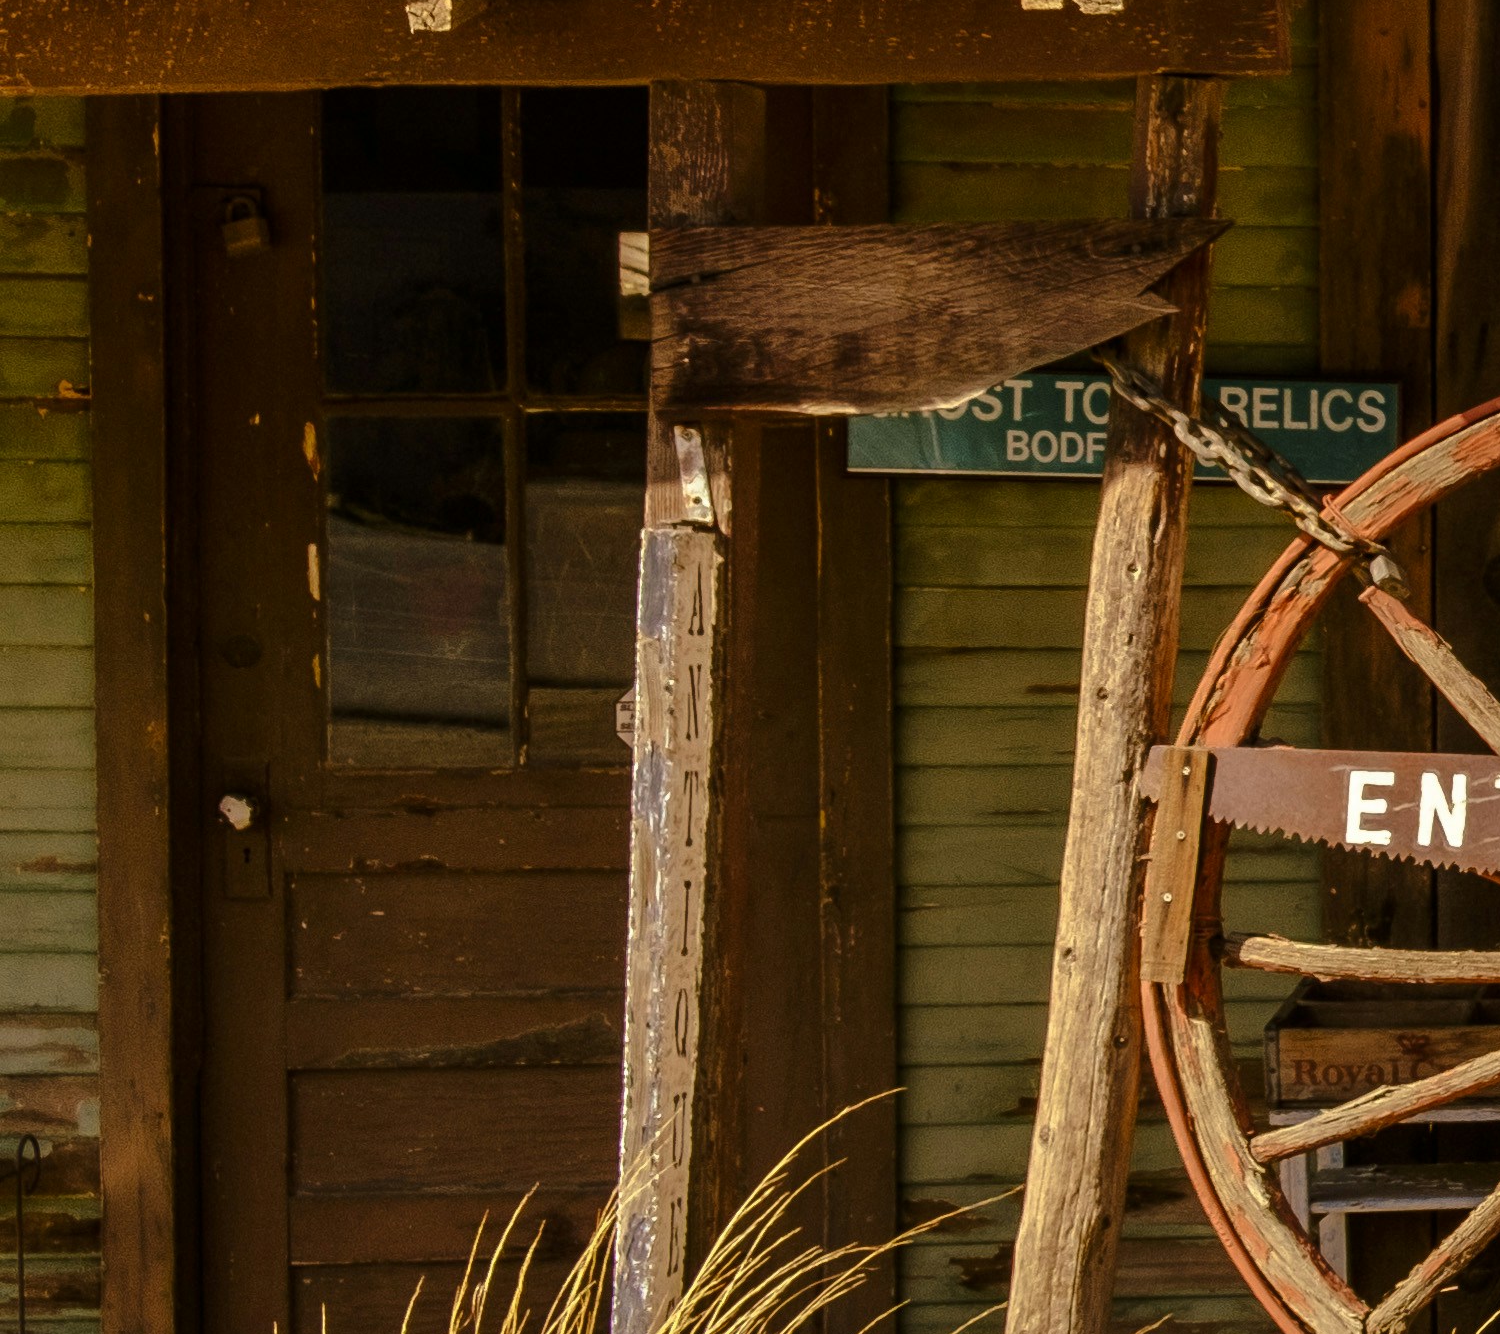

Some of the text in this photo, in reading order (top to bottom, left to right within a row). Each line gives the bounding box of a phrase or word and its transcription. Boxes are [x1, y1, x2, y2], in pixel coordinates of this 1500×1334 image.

[1055, 380, 1111, 425] TO
[1219, 385, 1387, 433] RELICS
[1007, 429, 1108, 464] BODF
[1292, 1057, 1400, 1087] Royal
